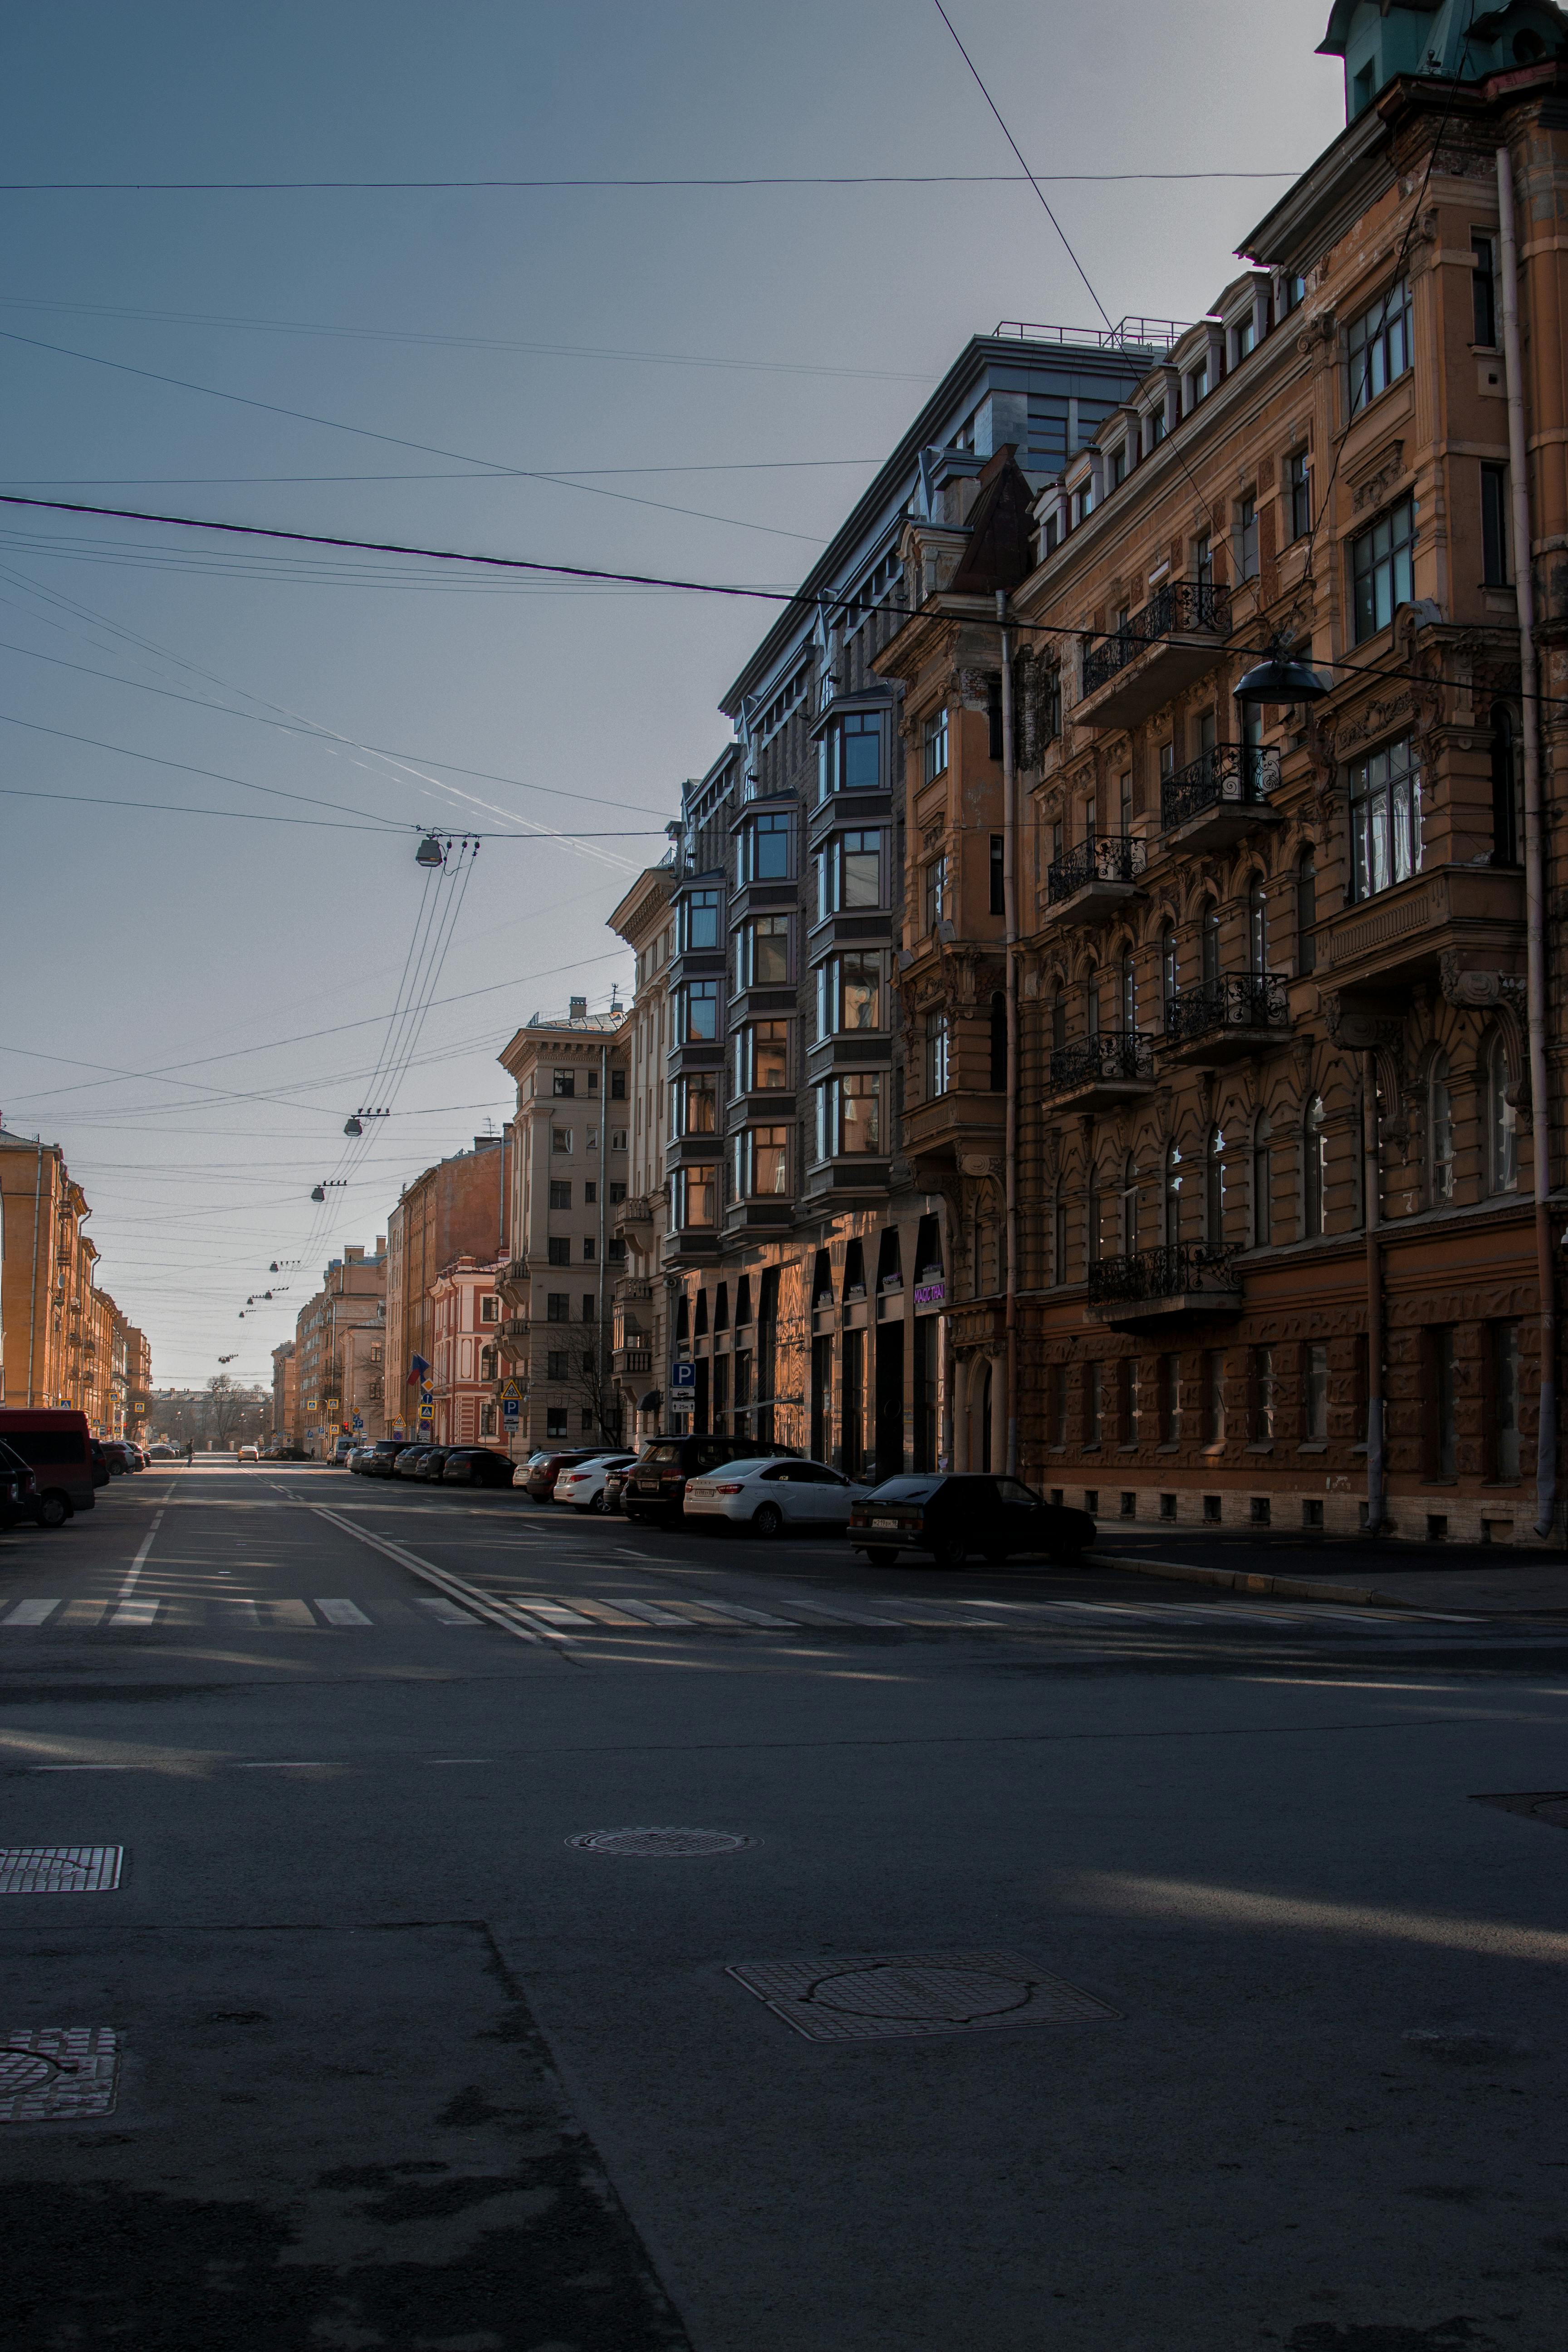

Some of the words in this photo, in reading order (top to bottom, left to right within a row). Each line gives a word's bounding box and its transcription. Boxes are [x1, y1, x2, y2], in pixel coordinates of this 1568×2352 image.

[914, 1287, 931, 1304] MAGIC
[931, 1284, 944, 1300] THAI
[679, 1366, 691, 1383] P
[508, 1401, 516, 1414] P
